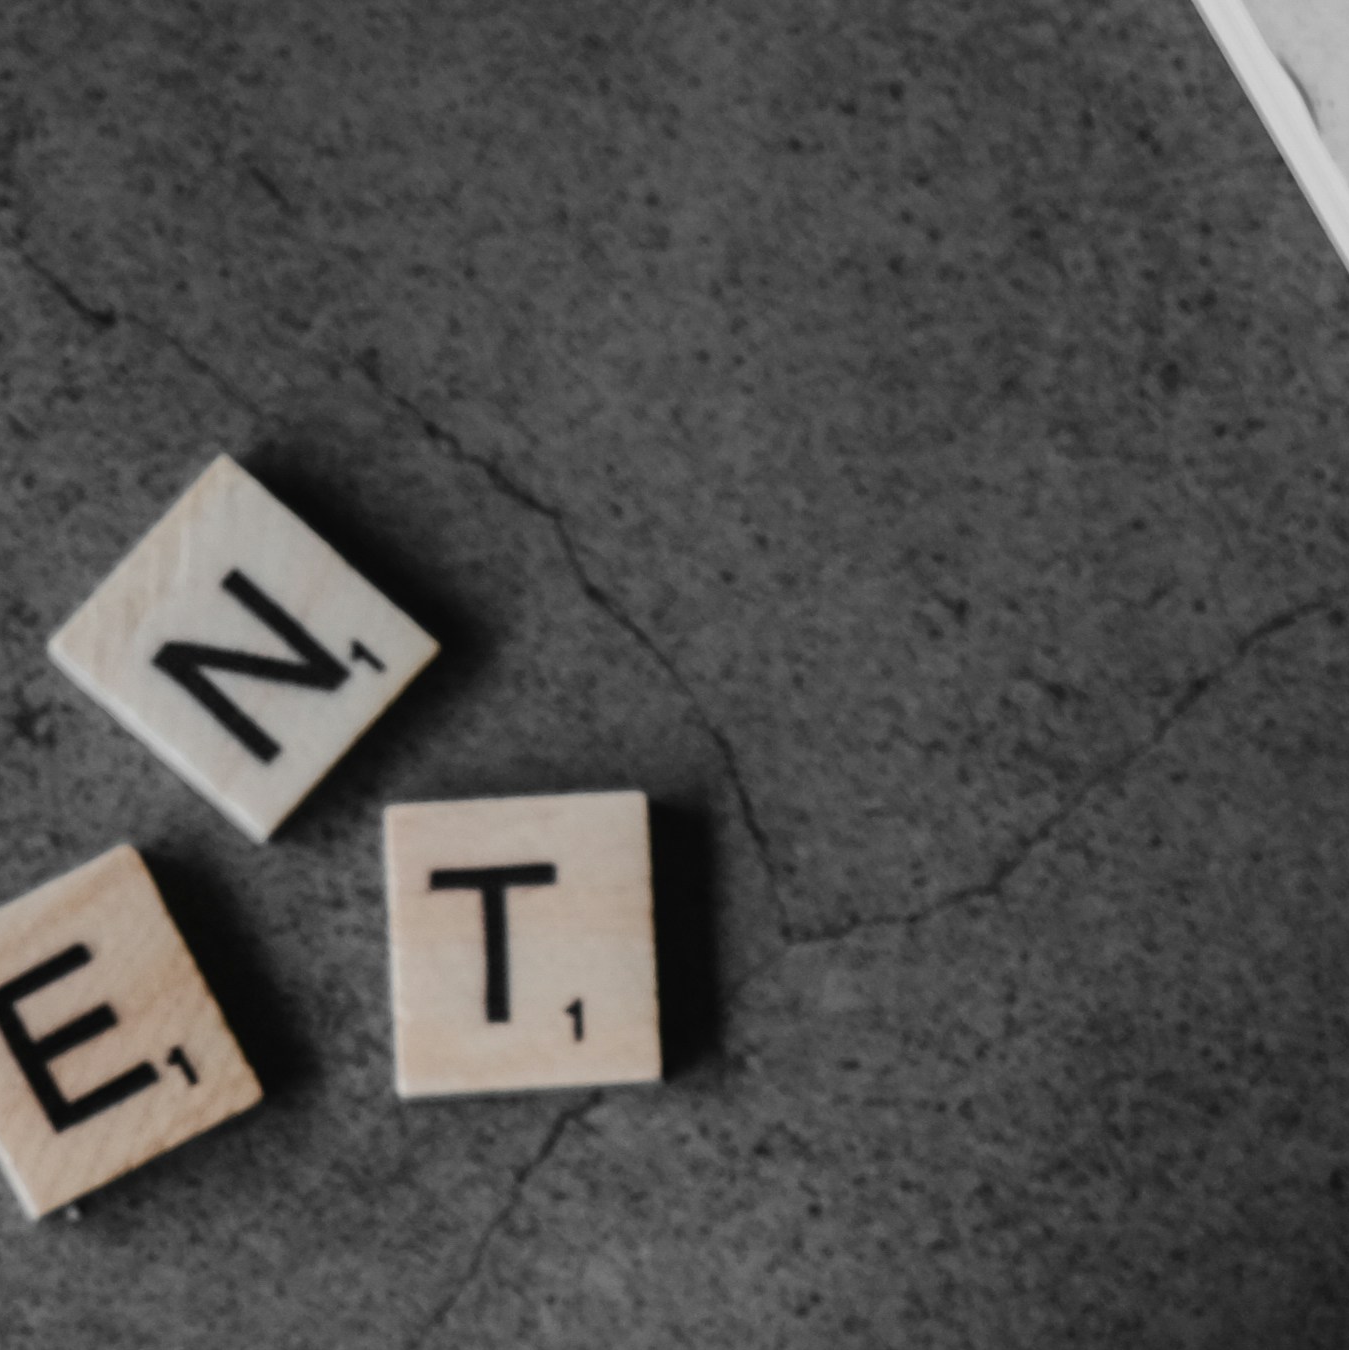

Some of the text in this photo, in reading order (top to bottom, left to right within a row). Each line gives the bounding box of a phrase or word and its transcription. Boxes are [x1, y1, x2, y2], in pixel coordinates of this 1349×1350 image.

[152, 569, 385, 764] N 1
[429, 863, 584, 1042] T 1
[165, 1044, 200, 1087] 1
